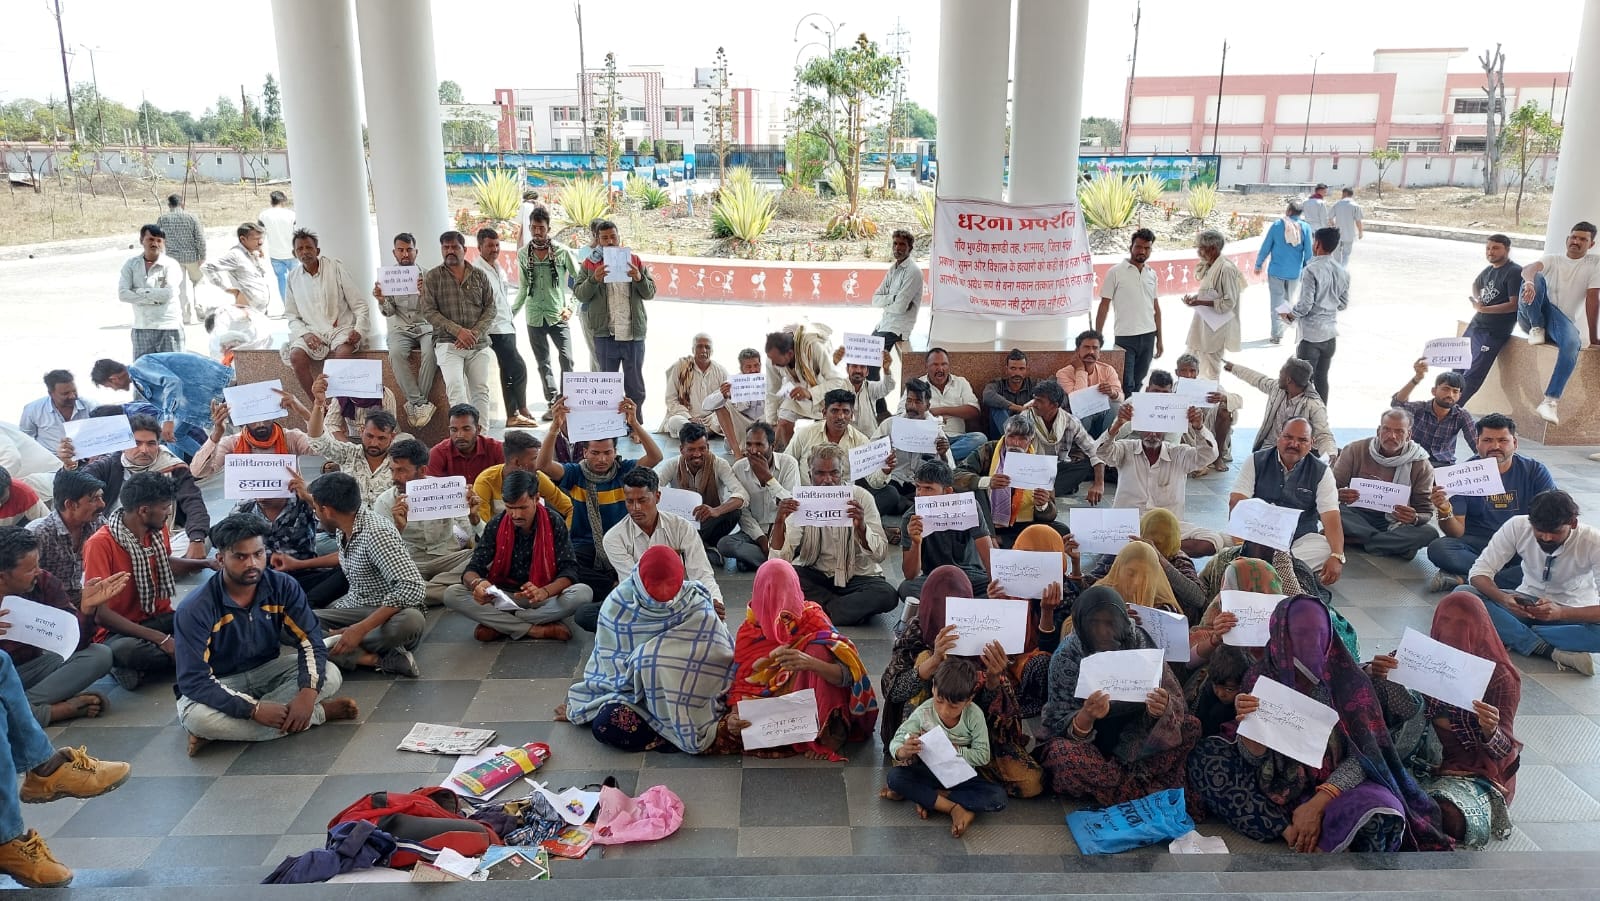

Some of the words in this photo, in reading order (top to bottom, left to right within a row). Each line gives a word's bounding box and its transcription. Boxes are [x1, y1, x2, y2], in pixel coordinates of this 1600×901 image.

[958, 213, 1013, 231] धरना
[958, 260, 972, 273] सुमन
[974, 259, 986, 272] और
[988, 258, 1008, 272] विशाल
[1009, 259, 1016, 271] के
[995, 278, 1001, 291] से
[1003, 281, 1014, 292] बना
[1016, 281, 1033, 292] मकान
[239, 479, 282, 490] हड़ताल
[805, 509, 842, 519] हड़ताल
